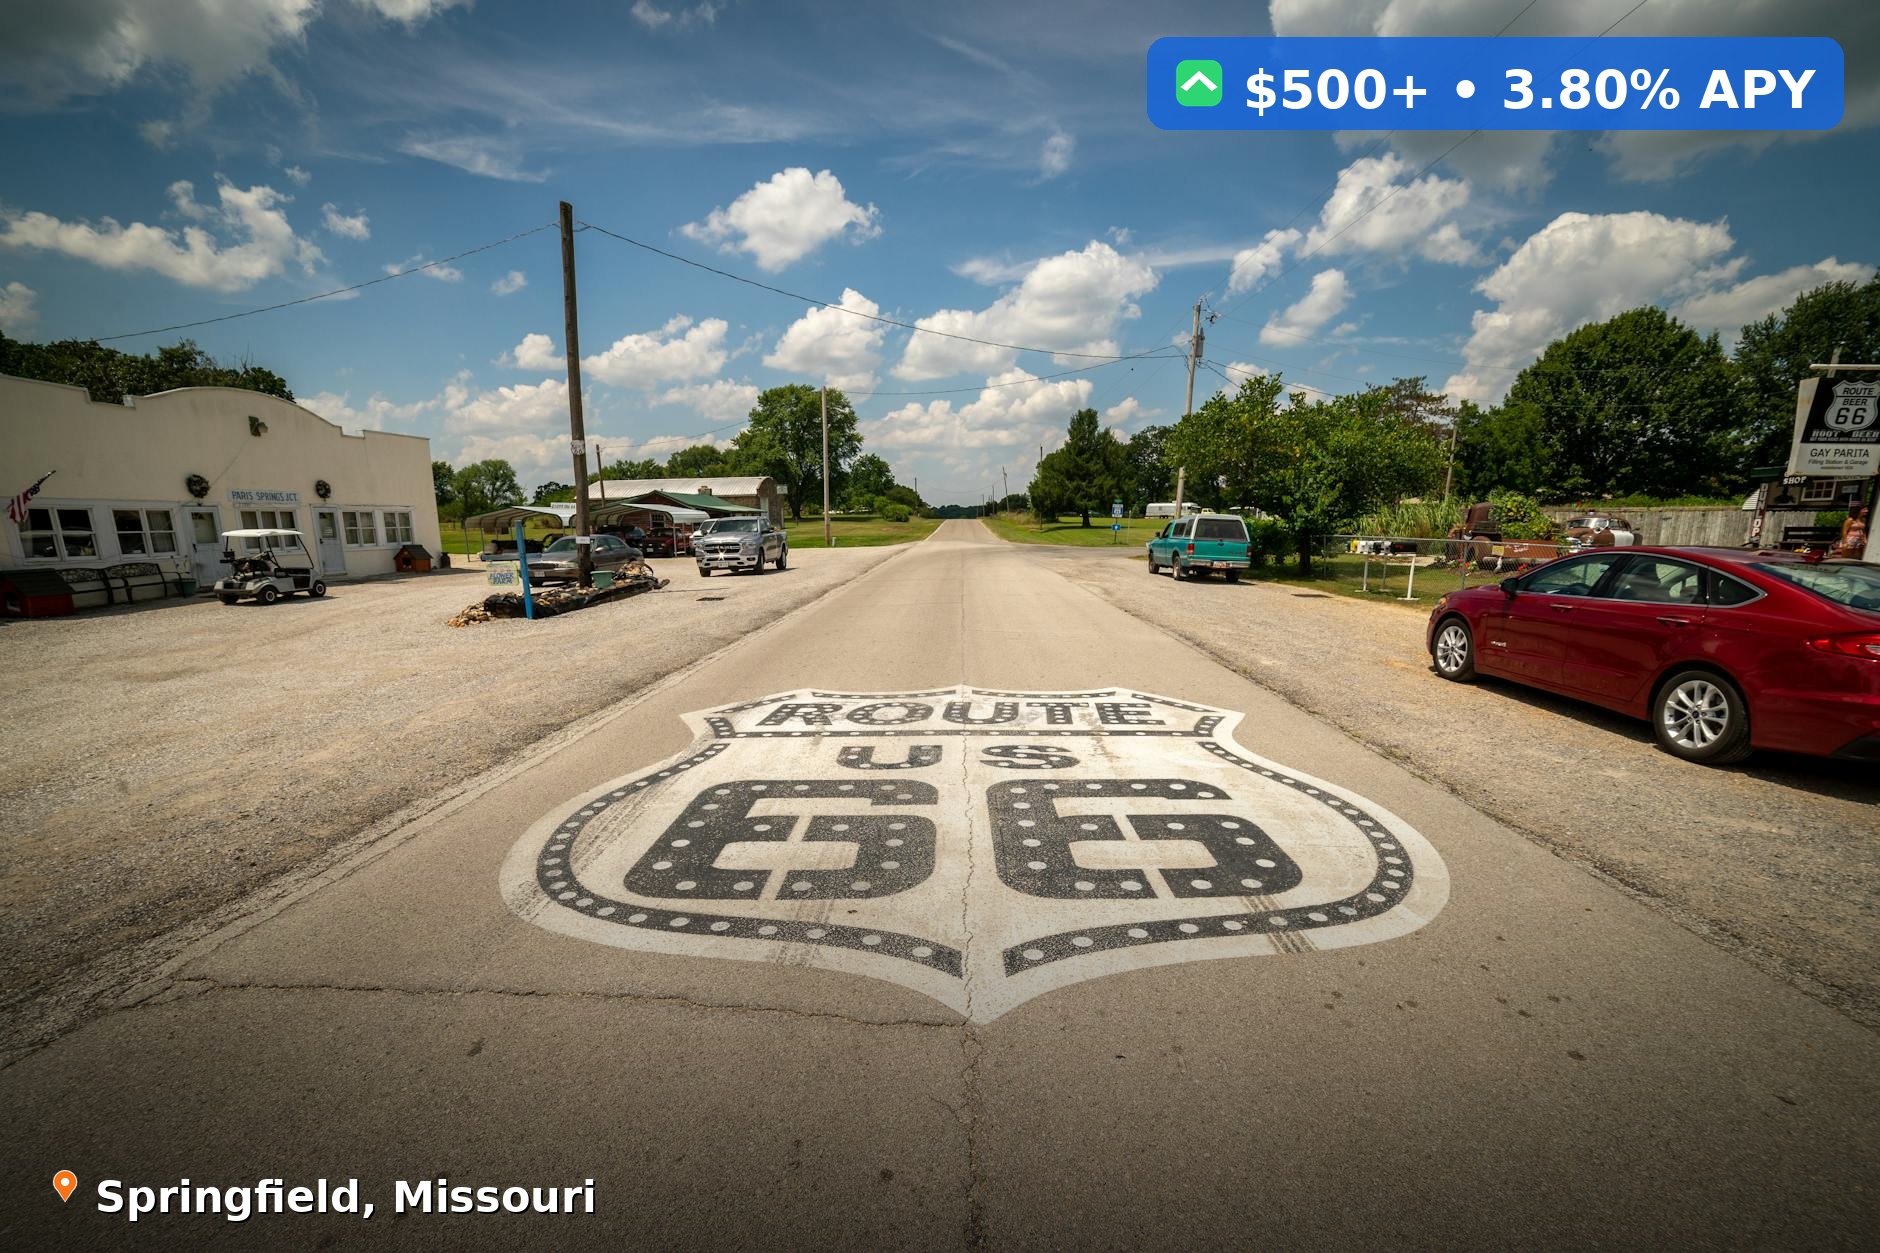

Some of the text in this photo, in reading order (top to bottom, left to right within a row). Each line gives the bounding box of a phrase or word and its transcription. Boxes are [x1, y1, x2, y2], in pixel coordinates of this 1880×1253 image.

[1842, 387, 1875, 396] ROUTE
[1842, 398, 1868, 406] BEER
[1835, 408, 1866, 425] 66
[1810, 448, 1870, 458] GAY PARITA
[231, 491, 253, 500] PARIS
[255, 491, 285, 501] SPRINGS
[759, 701, 1166, 726] ROUTE
[624, 779, 1302, 900] 66
